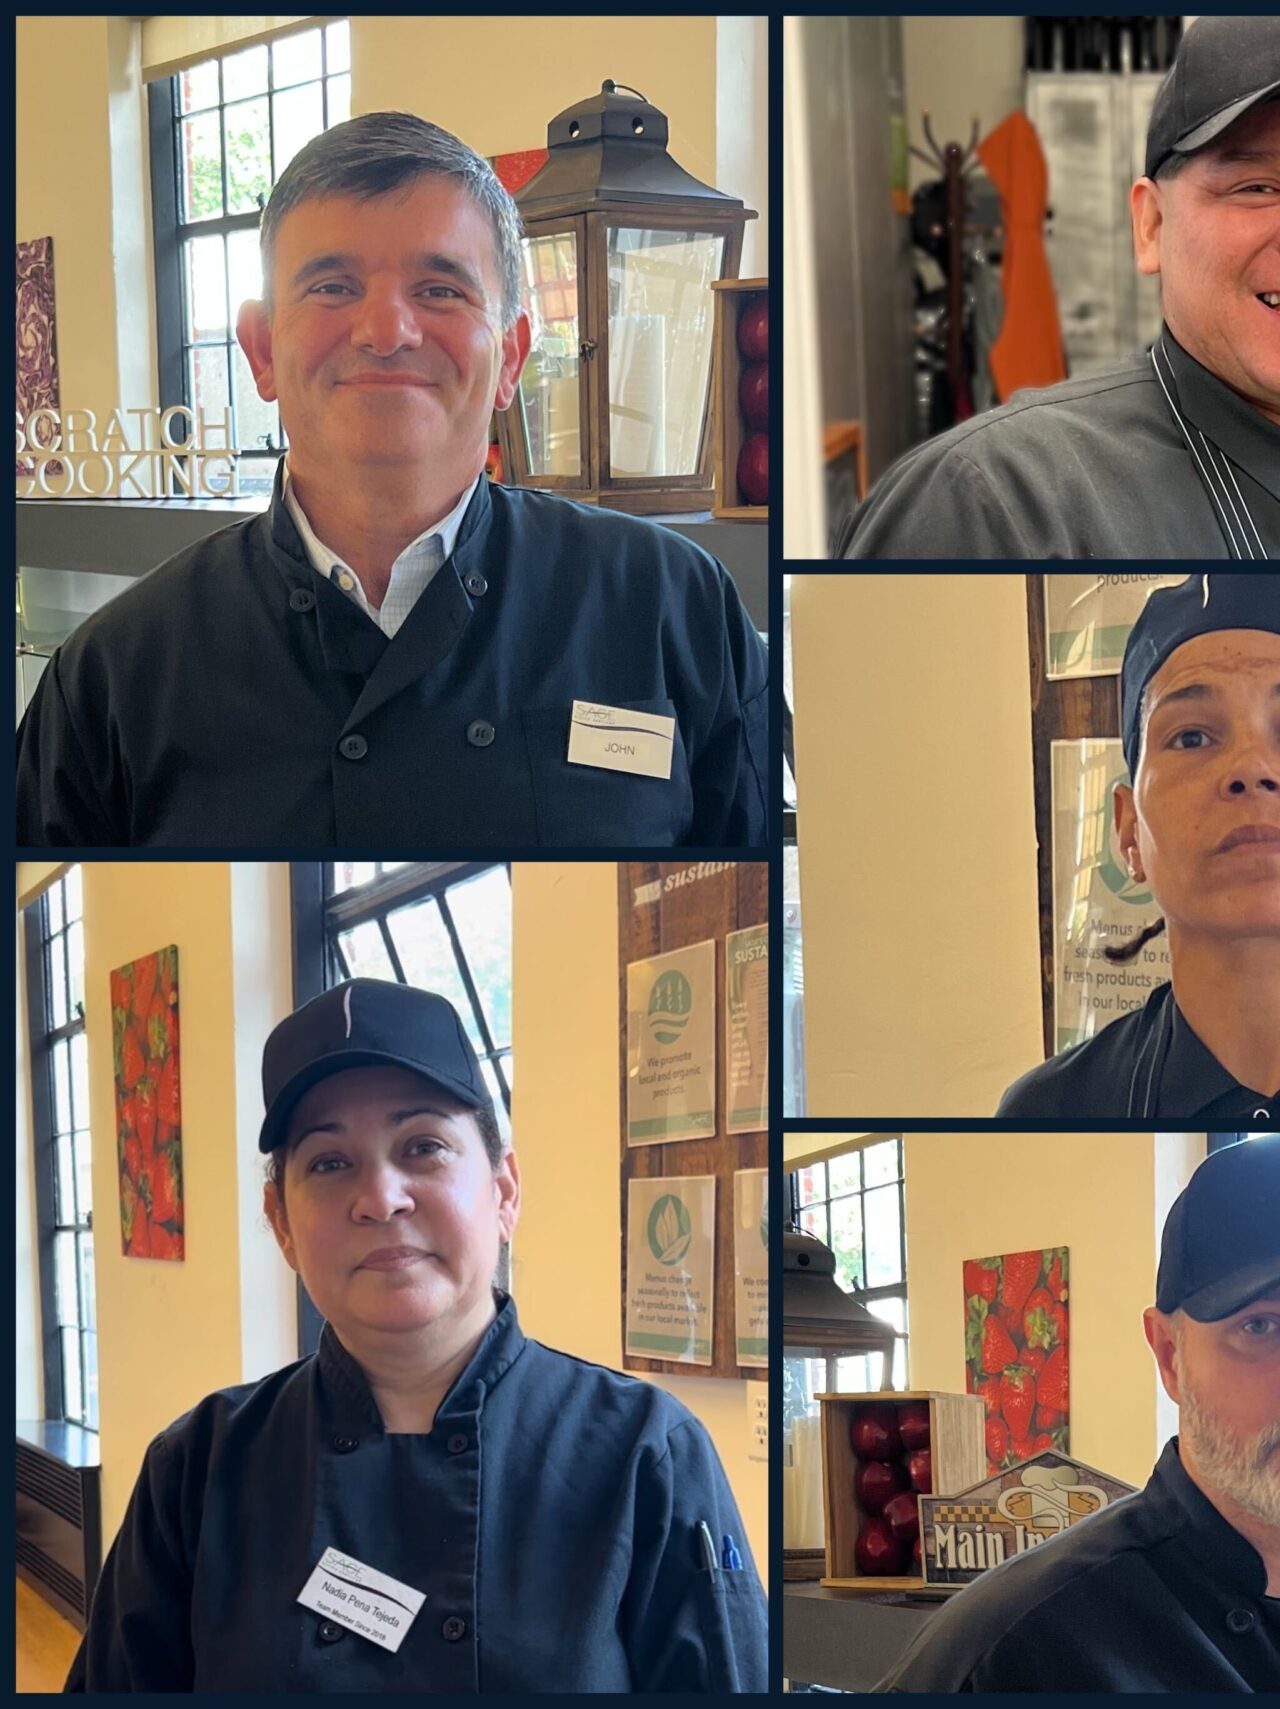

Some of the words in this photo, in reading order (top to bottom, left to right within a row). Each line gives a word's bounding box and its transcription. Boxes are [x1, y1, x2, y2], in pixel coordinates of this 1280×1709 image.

[604, 743, 635, 756] JOHN
[1090, 918, 1133, 935] Menus
[1143, 949, 1157, 963] to
[1096, 969, 1152, 989] products
[1092, 996, 1113, 1009] our
[934, 1524, 1005, 1570] Main
[321, 1581, 347, 1600] Nadia
[347, 1594, 371, 1613] Pena
[371, 1606, 400, 1628] Tejeda
